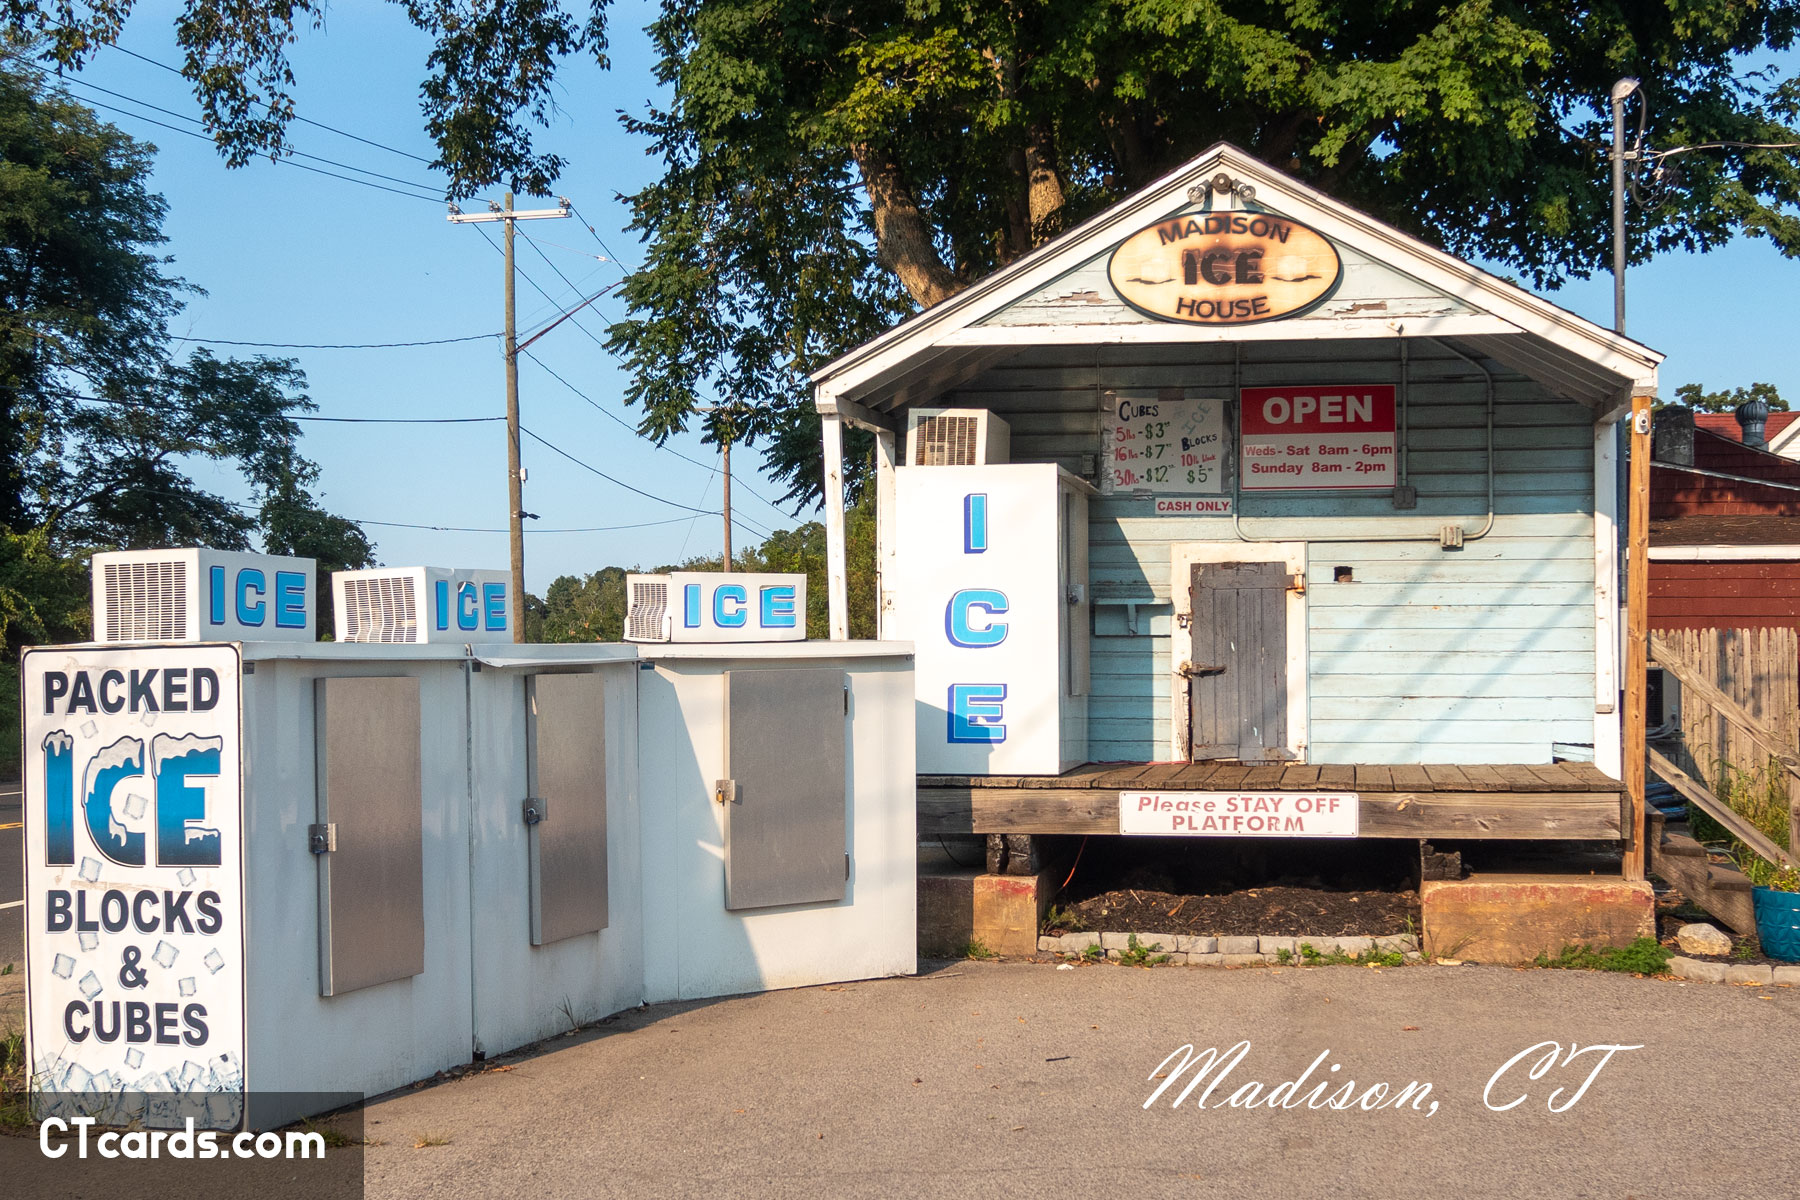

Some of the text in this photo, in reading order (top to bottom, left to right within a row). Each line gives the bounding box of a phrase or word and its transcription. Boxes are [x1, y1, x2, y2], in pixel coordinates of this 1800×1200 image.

[1157, 216, 1291, 245] MADISON
[1181, 247, 1266, 285] ICE
[1176, 296, 1270, 319] HOUSE
[1262, 395, 1373, 424] OPEN
[1251, 462, 1303, 475] Sunday
[1311, 462, 1342, 473] 8am
[1355, 461, 1386, 474] 2pm
[1286, 445, 1310, 456] Sat
[1318, 445, 1349, 456] 8am
[1362, 444, 1392, 457] 6pm
[1157, 501, 1230, 511] CASH ONLY
[209, 565, 307, 629] ICE
[436, 580, 507, 632] ICE
[684, 584, 796, 628] ICE
[945, 493, 1009, 744] ICE
[43, 667, 220, 716] PACKED
[42, 729, 223, 868] ICE
[1137, 796, 1341, 814] Please STAY OFF
[1172, 815, 1305, 832] PLATFORM
[45, 889, 223, 935] BLOCKS
[118, 945, 149, 990] &
[63, 1000, 210, 1047] CUBES
